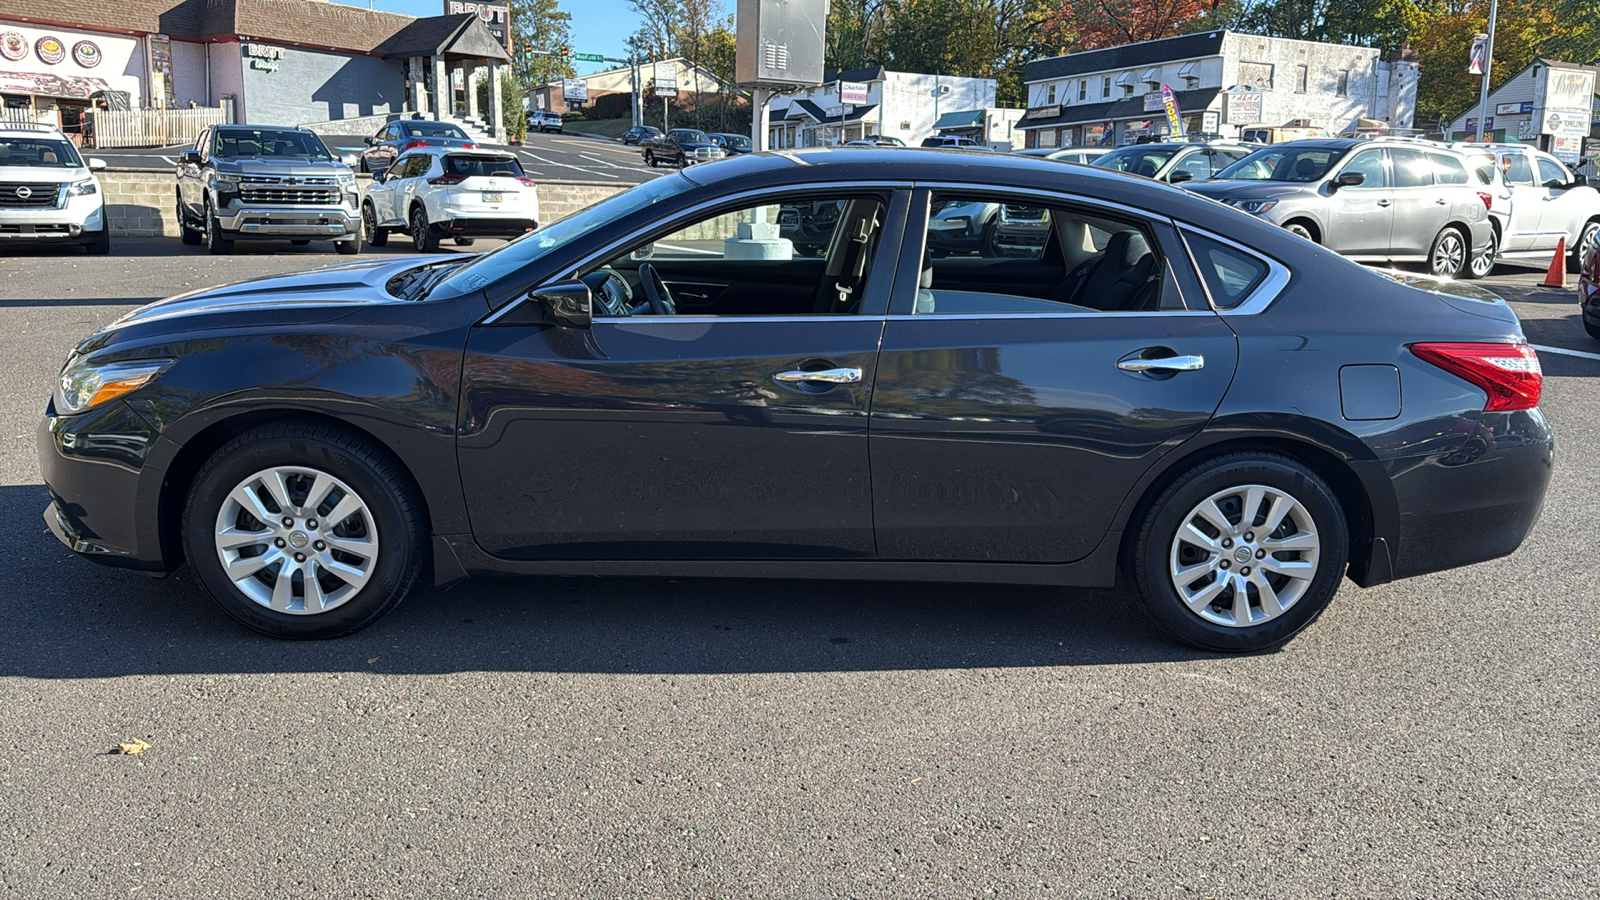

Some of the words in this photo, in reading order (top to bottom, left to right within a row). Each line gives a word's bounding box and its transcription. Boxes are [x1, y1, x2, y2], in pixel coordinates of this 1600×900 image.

[449, 1, 508, 24] BRUT
[248, 43, 285, 59] BRUT
[1229, 101, 1260, 109] COMPUTERS
